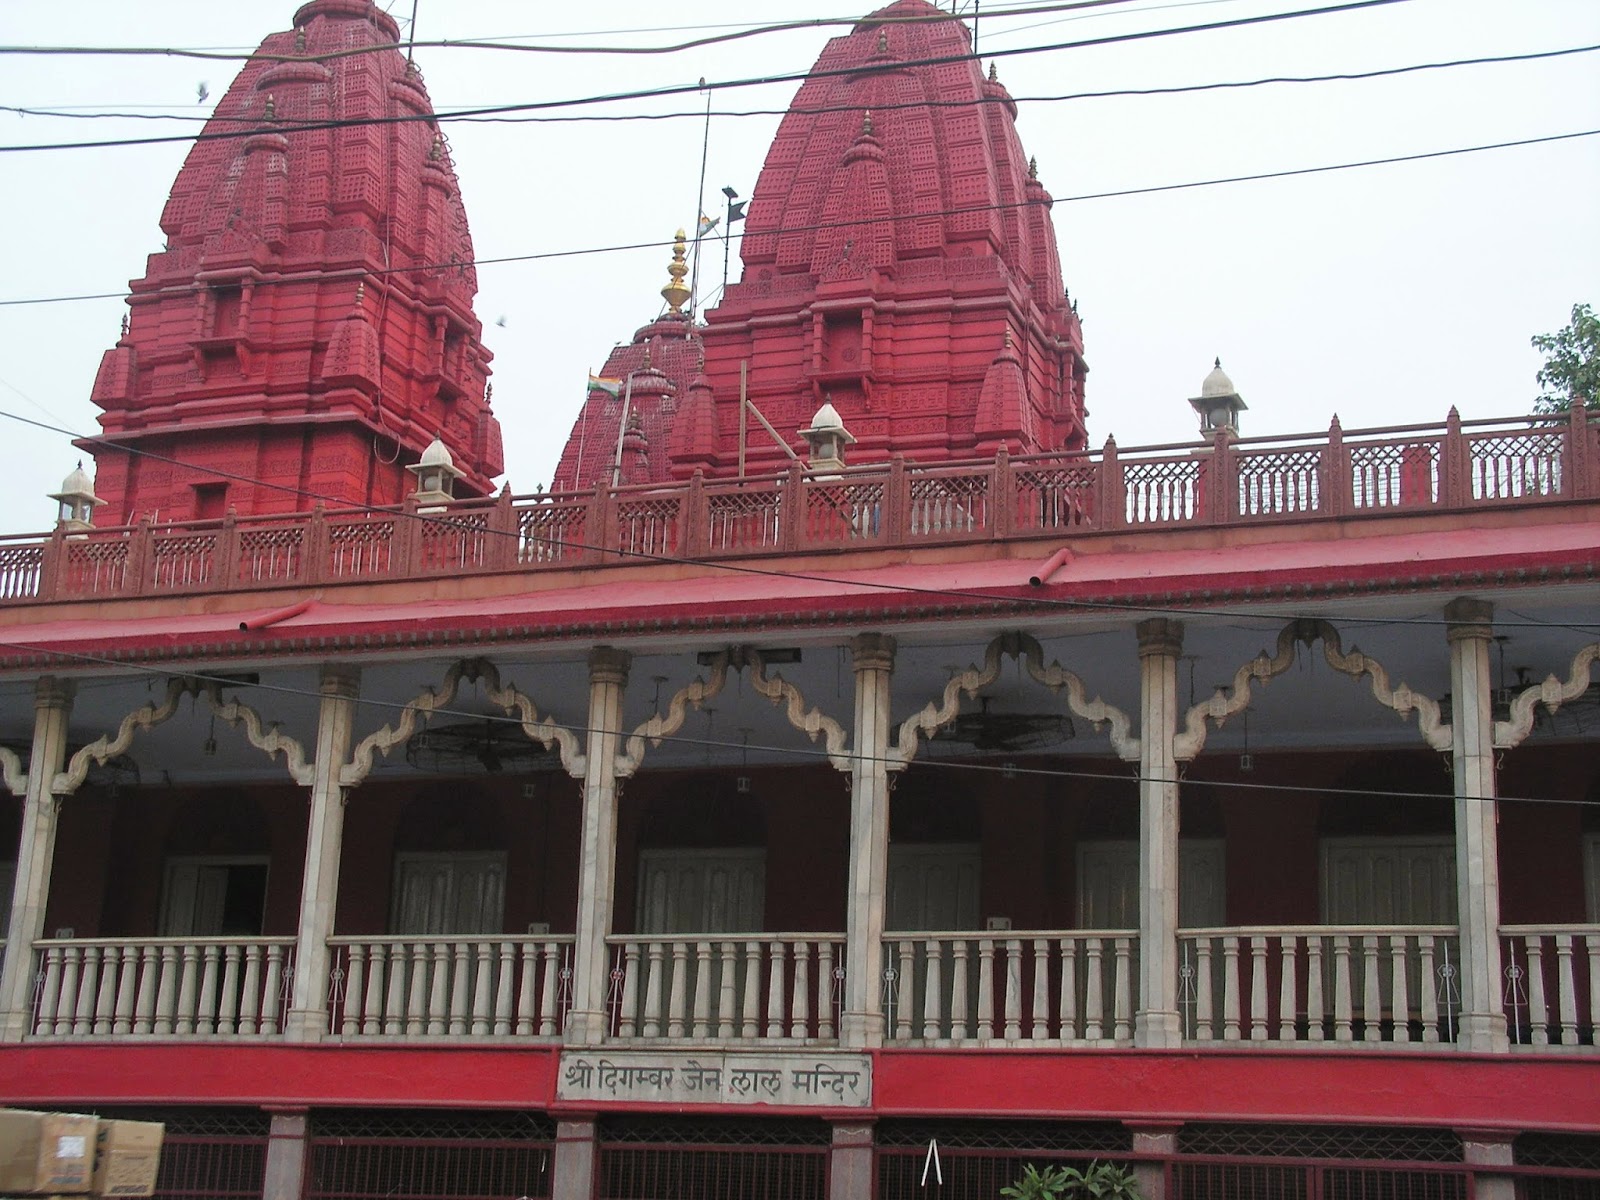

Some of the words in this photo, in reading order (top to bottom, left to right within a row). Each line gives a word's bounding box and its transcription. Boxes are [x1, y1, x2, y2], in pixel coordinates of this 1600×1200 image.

[565, 1059, 593, 1089] श्री
[681, 1060, 721, 1091] जैन
[731, 1069, 782, 1097] लाल
[791, 1063, 861, 1101] मन्दिर
